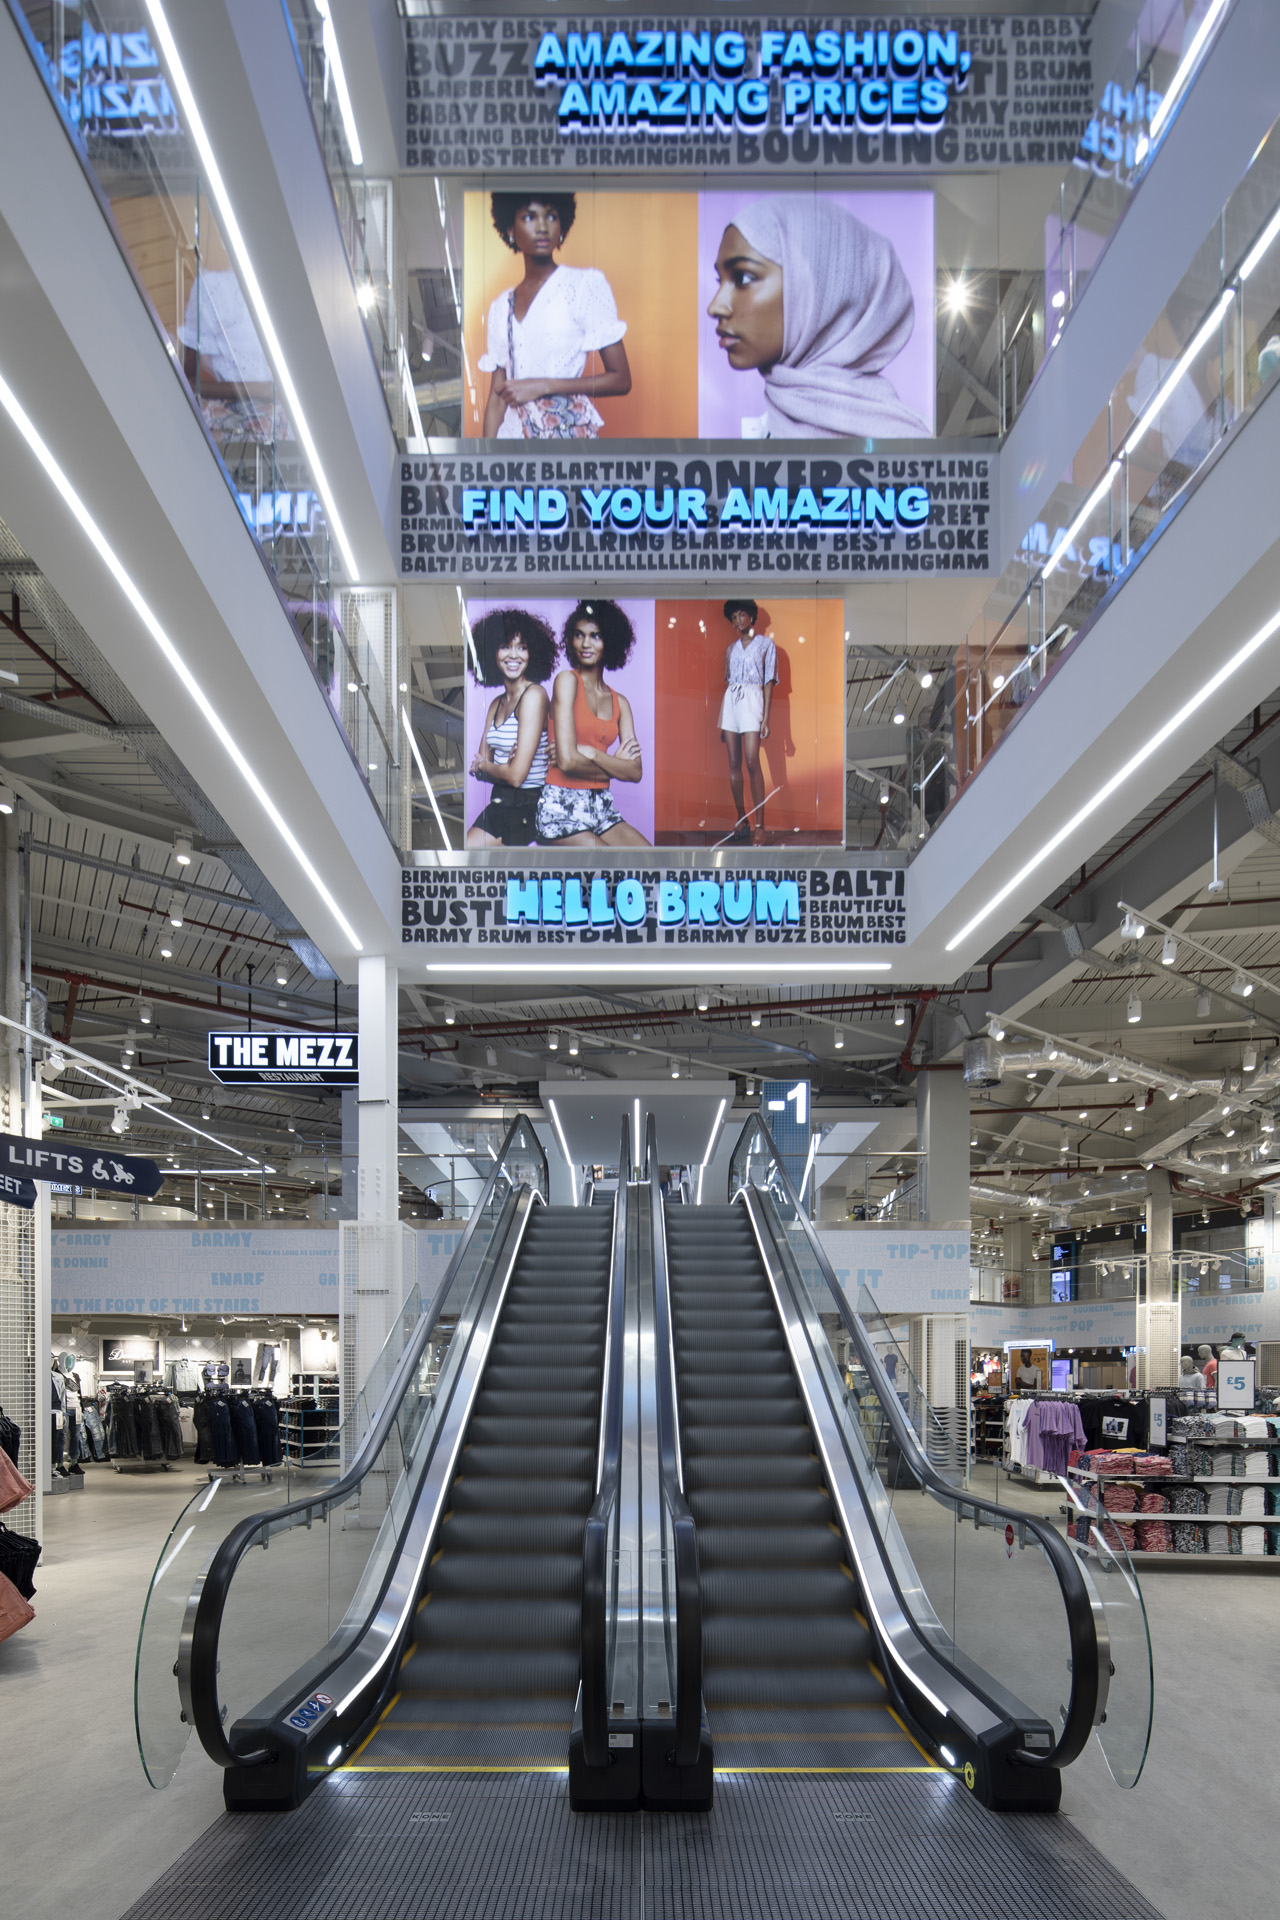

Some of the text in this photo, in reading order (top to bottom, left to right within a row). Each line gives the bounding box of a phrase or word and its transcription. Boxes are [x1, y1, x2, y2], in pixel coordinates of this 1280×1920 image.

[406, 20, 498, 39] BARMY
[502, 20, 557, 39] BEST
[696, 18, 760, 37] BRUM
[1011, 18, 1093, 38] BABBY
[534, 31, 747, 70] AMAZING
[761, 29, 971, 73] FASHION,
[1015, 39, 1093, 57] BARMY
[407, 43, 530, 77] BUZZ
[1014, 60, 1092, 80] BRUM
[558, 80, 949, 117] AMAZING PRICES
[407, 103, 478, 125] BABBY
[1013, 101, 1093, 115] BONKERS
[407, 128, 503, 146] BULLRING
[965, 128, 1004, 139] BRUM
[1009, 120, 1088, 138] BRUMMI
[737, 129, 959, 165] BOUNCING
[407, 147, 731, 167] BROADSTREET BIRMINGHAM
[401, 461, 650, 482] BUZZ BLOKE BLARTIN'
[878, 460, 989, 478] BUSTLING
[462, 488, 567, 524] FIND
[581, 487, 708, 523] YOUR
[401, 529, 989, 553] BRUMMIE BULLRING BLABBERIN' BEST BLOKE
[401, 556, 456, 573] BALTI
[462, 555, 518, 572] BUZZ
[748, 553, 822, 571] BLOKE
[827, 552, 989, 571] BIRMINGHAM
[401, 870, 807, 884] BIRMINGHAM BARMY BRUM BALTI BULLRING
[810, 870, 905, 897] BALTI
[401, 885, 507, 898] BRUM BLOK
[506, 879, 800, 924] HELLO BRUM
[809, 899, 906, 913] BEAUTIFUL
[810, 915, 906, 929] BRUM BEST
[401, 928, 576, 943] BARMY BRUM BEST
[678, 929, 807, 943] BARMY BUZZ
[811, 930, 906, 943] BOUNCING
[214, 1037, 353, 1067] THE MEZZ
[258, 1072, 325, 1082] RESTAURANT
[768, 1082, 807, 1124] -1
[8, 1145, 84, 1174] LIFTS
[191, 1232, 253, 1248] BARMY
[886, 1243, 969, 1260] TIP-TOP
[63, 1257, 109, 1268] DONNIE
[211, 1272, 265, 1286] ENARF
[857, 1268, 883, 1289] IT
[930, 1288, 969, 1300] ENARF
[1190, 1294, 1263, 1308] ARGY-BARGY
[51, 1298, 260, 1312] TO THE FOOT OF THE STAIRS
[1073, 1304, 1114, 1314] BOUNCING
[1070, 1320, 1094, 1332] POP
[1188, 1324, 1263, 1335] ARK AT THAT
[1098, 1336, 1125, 1345] GULLY
[1226, 1376, 1246, 1391] £5
[1153, 1413, 1163, 1427] £5
